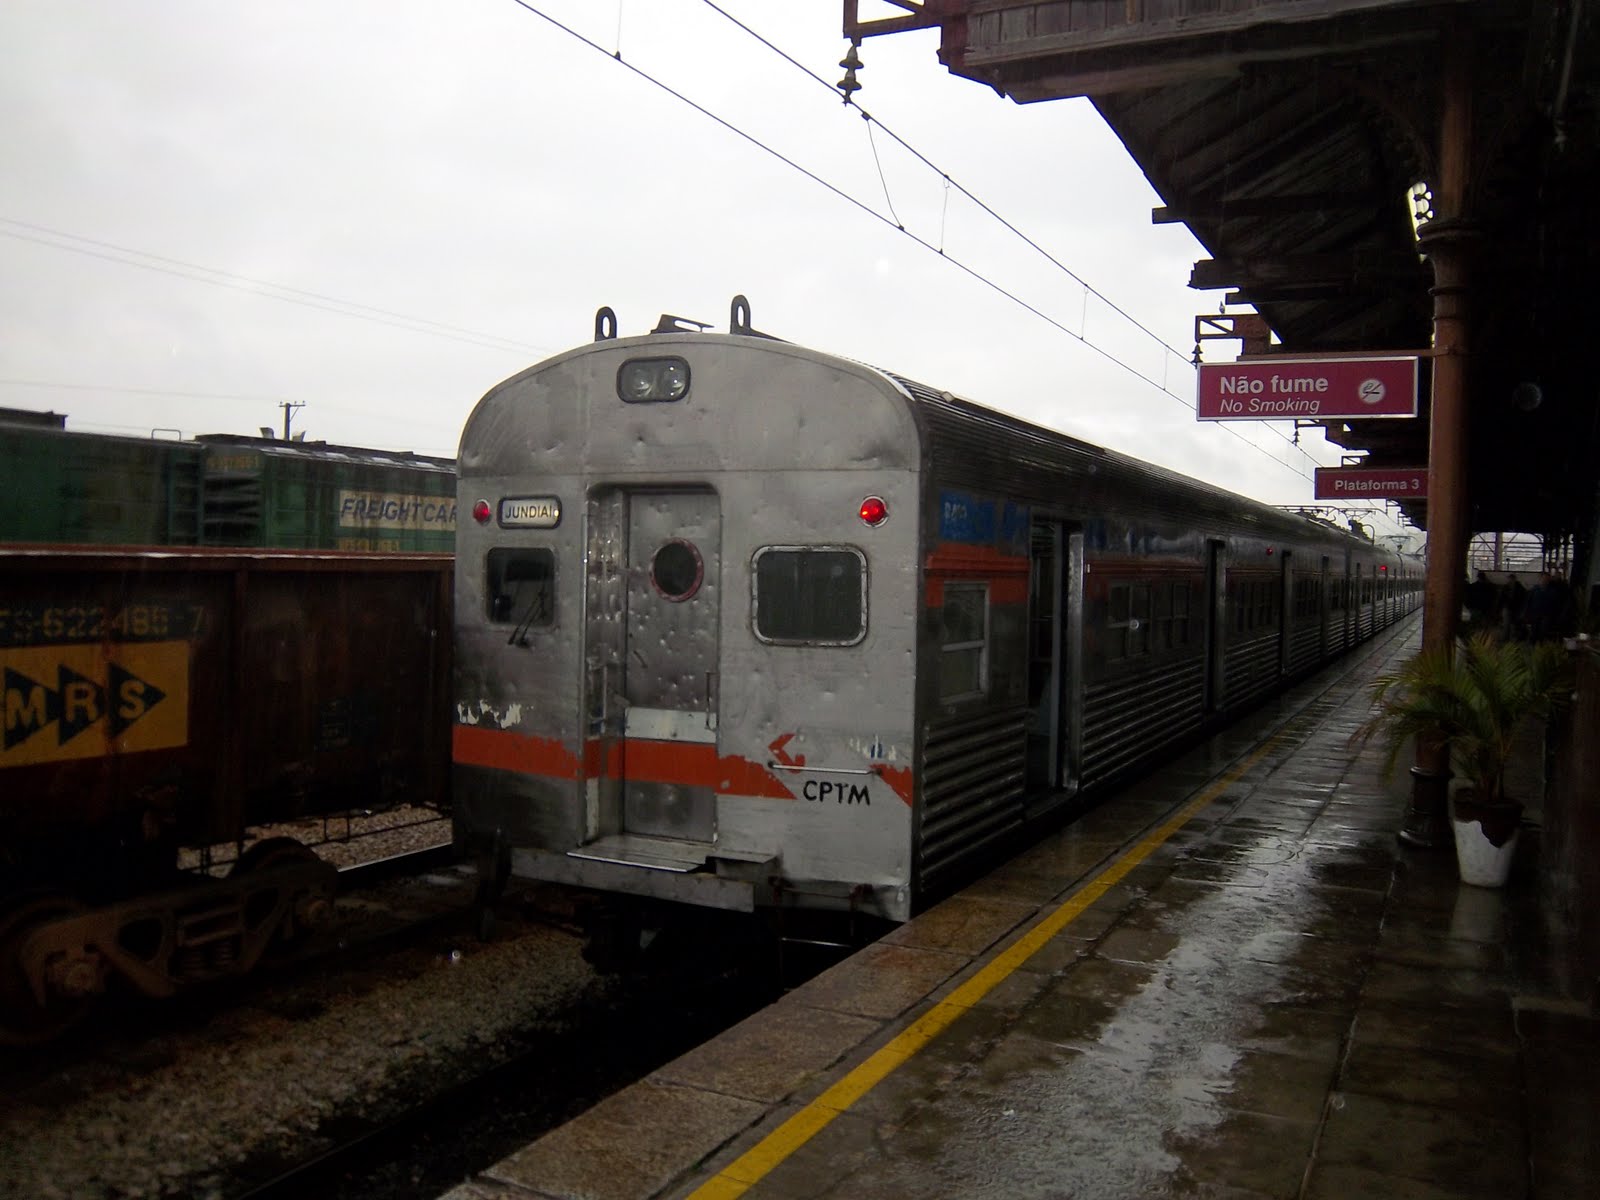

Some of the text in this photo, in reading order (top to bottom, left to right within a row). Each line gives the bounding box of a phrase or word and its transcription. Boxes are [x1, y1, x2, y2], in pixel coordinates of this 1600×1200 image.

[1219, 375, 1329, 394] Não fume
[1219, 398, 1321, 414] No Smoking
[1334, 479, 1420, 491] Plataforma 3
[5, 679, 146, 731] MRS
[803, 780, 871, 806] CPTM
